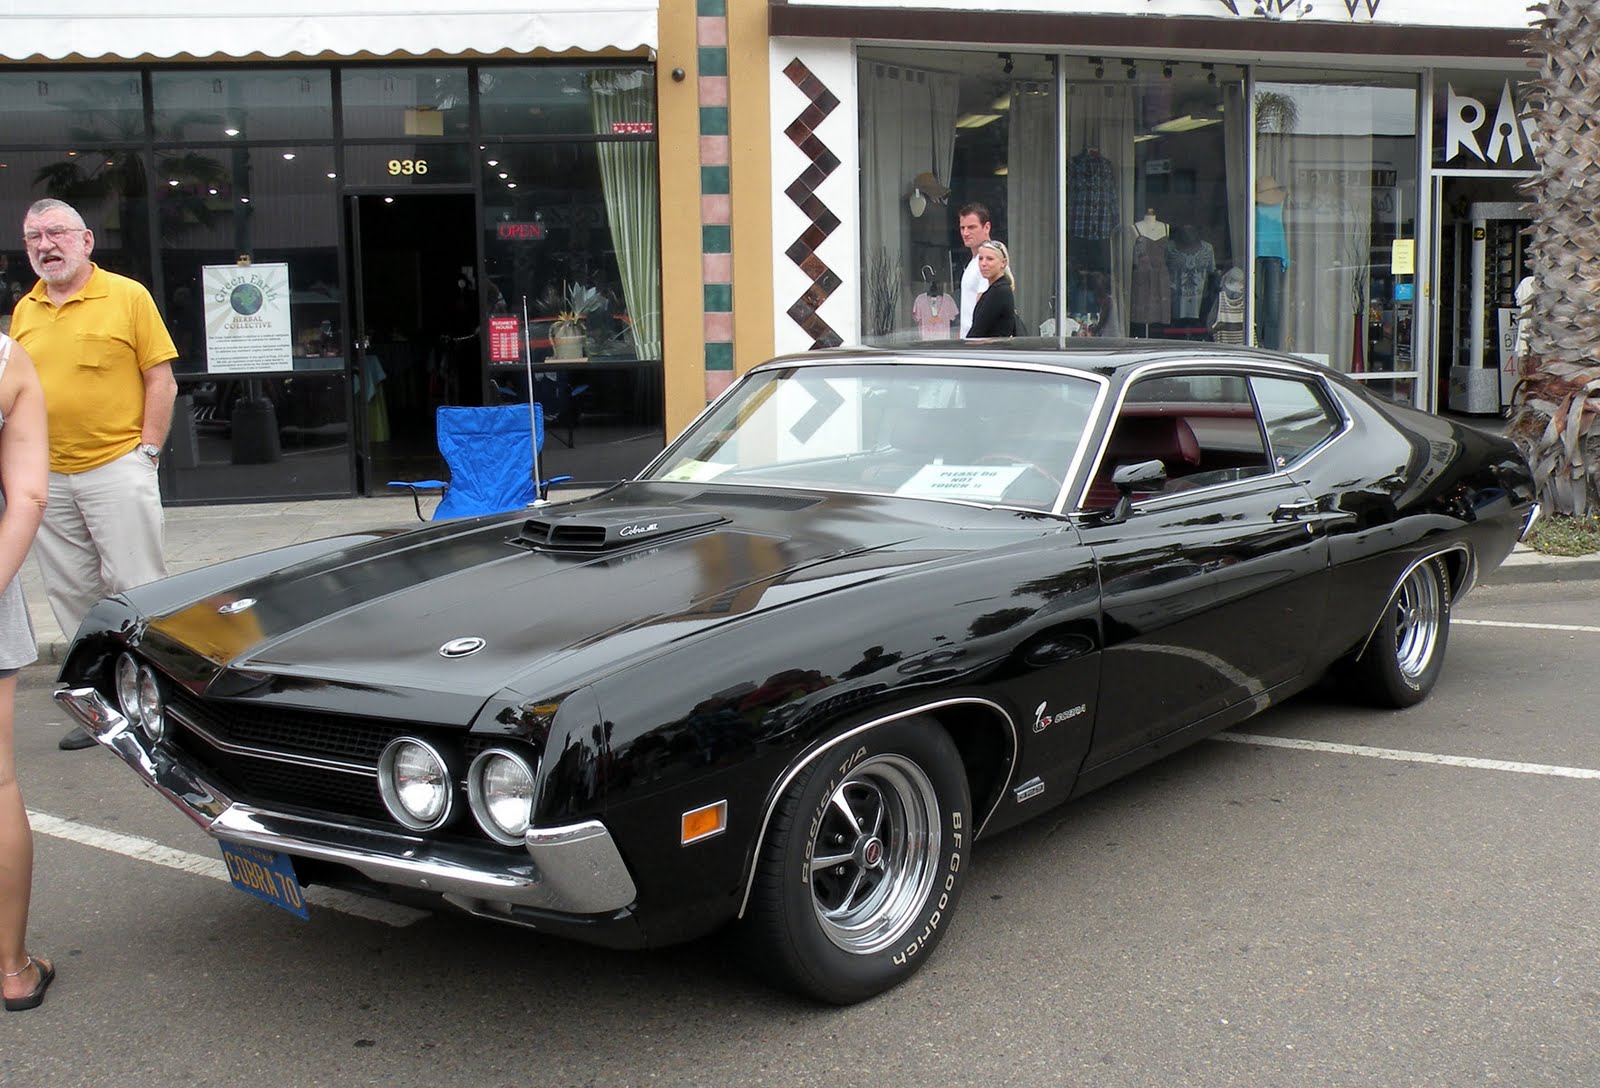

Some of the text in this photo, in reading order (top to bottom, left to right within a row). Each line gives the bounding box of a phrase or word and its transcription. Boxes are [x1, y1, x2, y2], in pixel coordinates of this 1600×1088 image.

[388, 159, 428, 175] 936
[498, 223, 541, 239] OPEN
[215, 274, 278, 303] Green Earth
[224, 321, 273, 330] COLLECTIVE
[233, 315, 263, 323] HERBAL
[619, 524, 646, 537] Cobra
[802, 746, 867, 884] Radial T/A
[224, 851, 302, 909] COBRA 70
